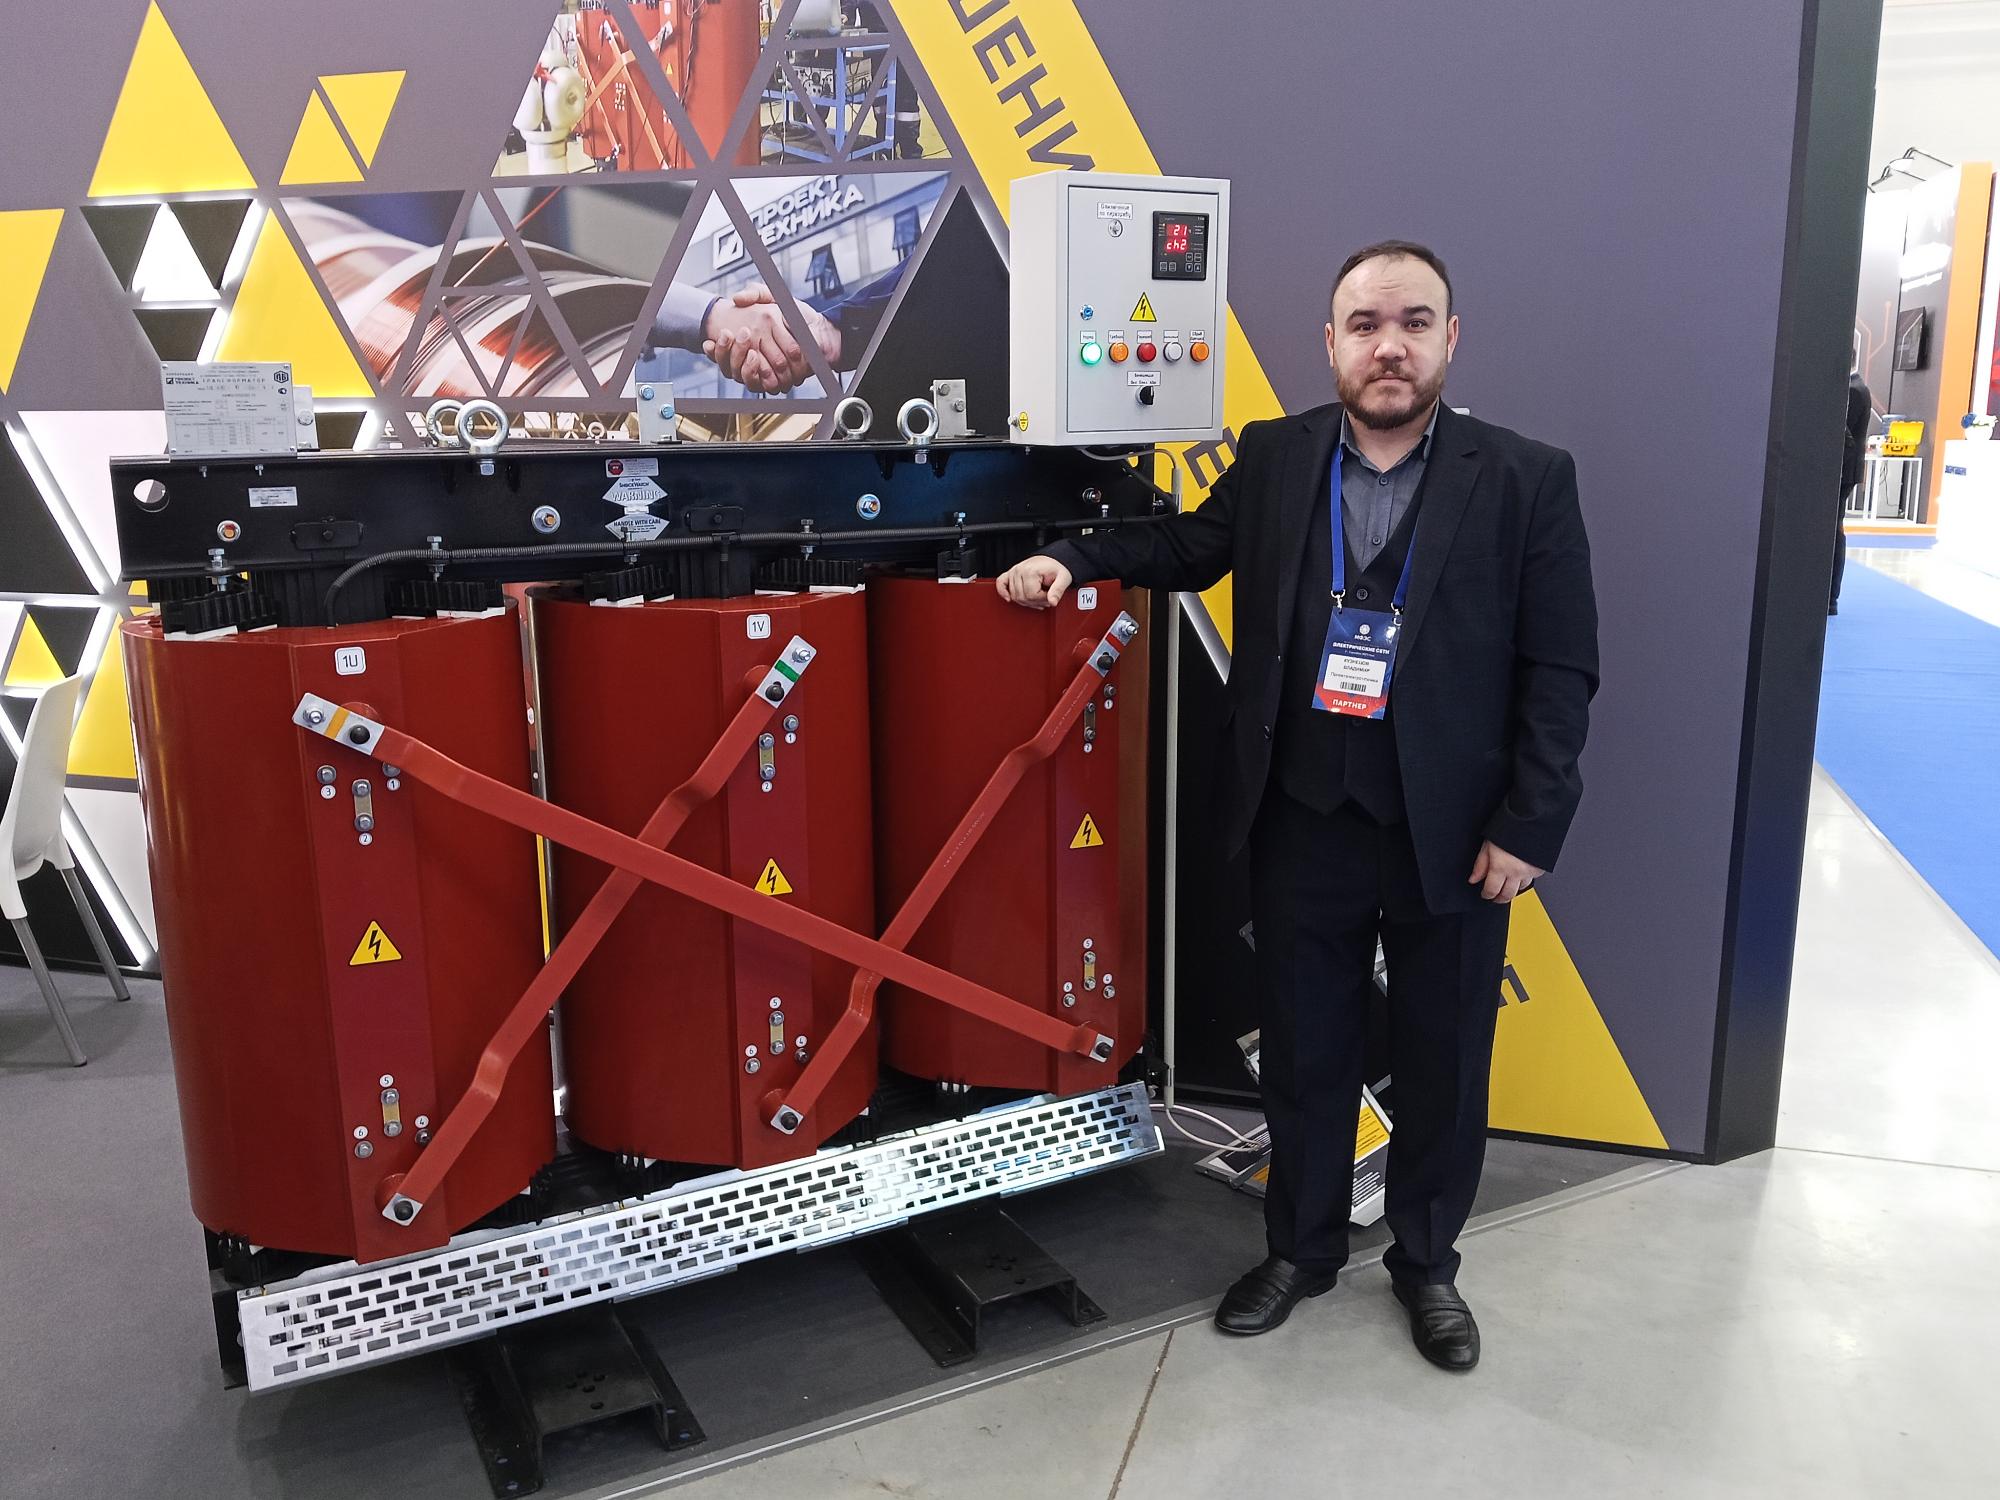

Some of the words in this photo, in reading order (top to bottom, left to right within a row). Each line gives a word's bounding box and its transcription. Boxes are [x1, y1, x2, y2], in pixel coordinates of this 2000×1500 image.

[757, 183, 865, 247] ЕХНИКА
[1173, 224, 1187, 236] 21
[1166, 238, 1187, 251] ch2
[611, 490, 661, 502] WARNING
[1081, 593, 1094, 605] 1W
[751, 620, 766, 632] 1V
[1375, 647, 1391, 655] СЕТИ
[342, 654, 358, 668] 1U
[1332, 699, 1367, 710] ПАРТНЕР
